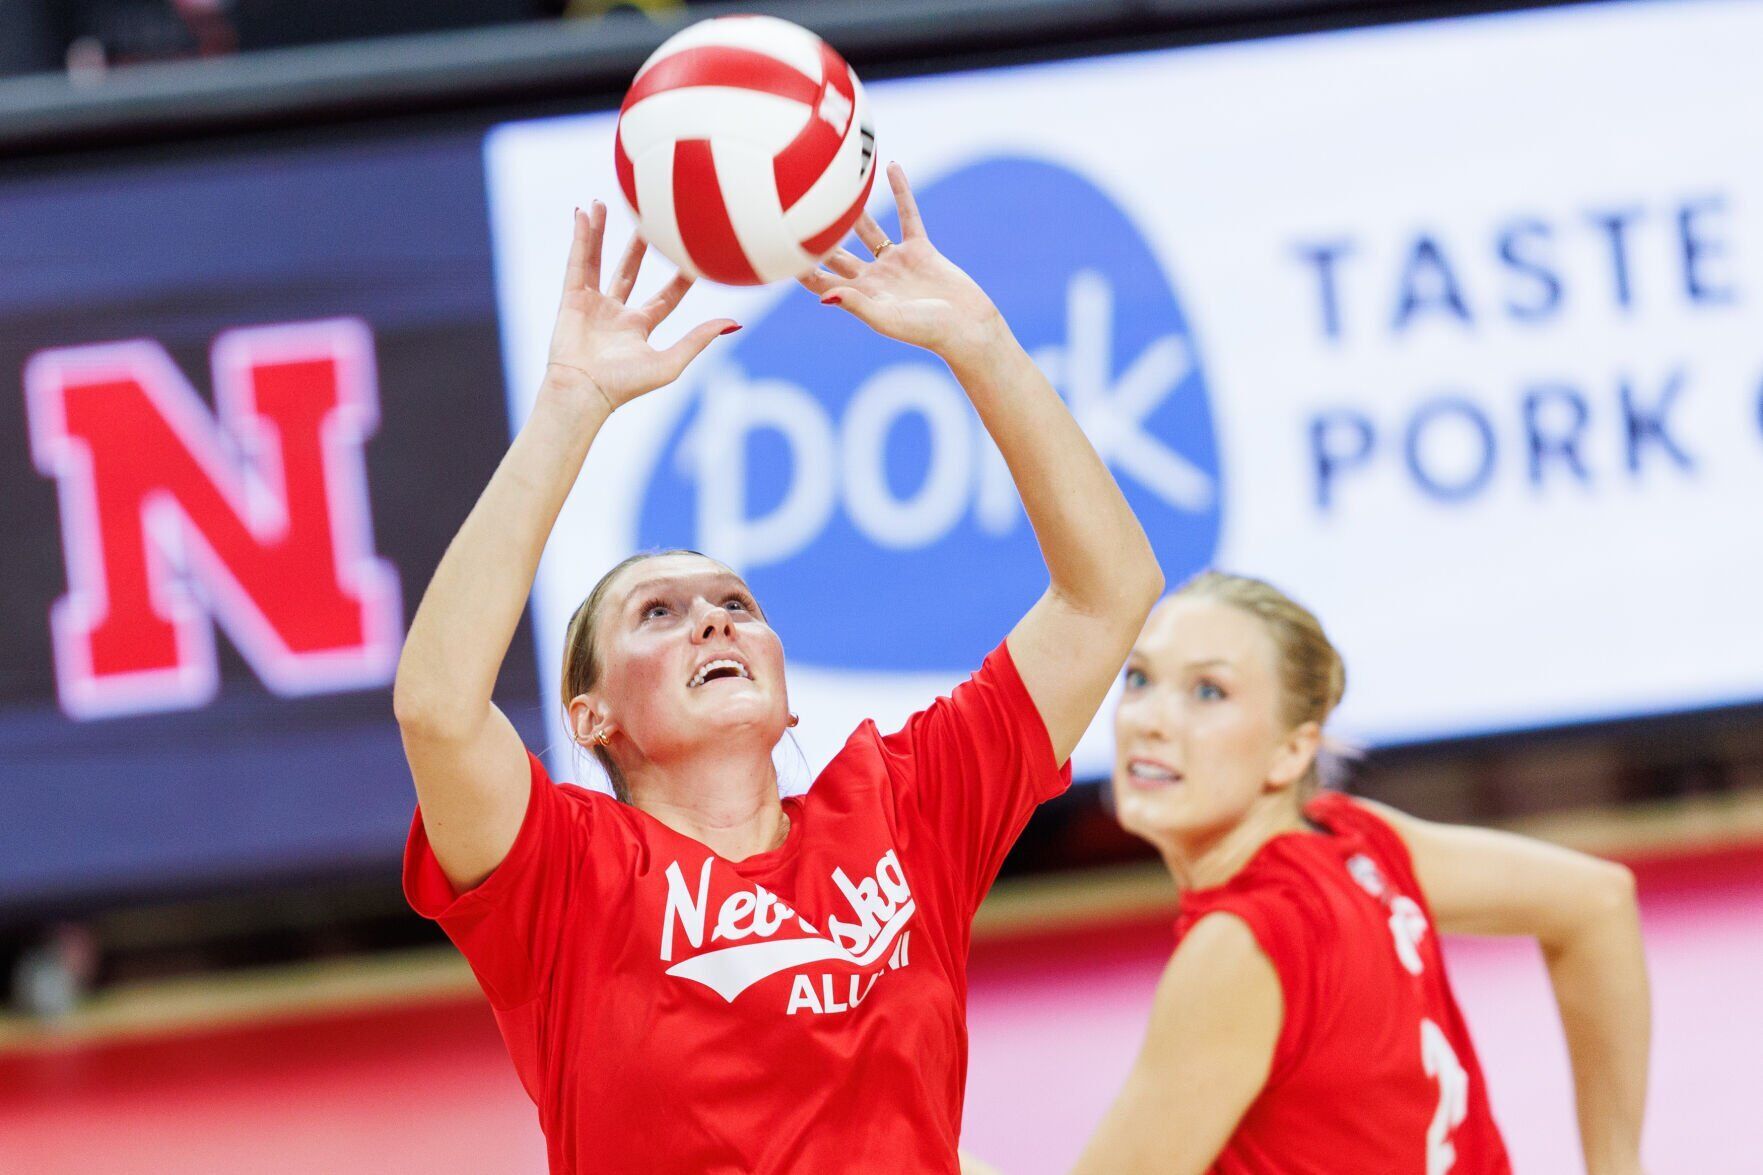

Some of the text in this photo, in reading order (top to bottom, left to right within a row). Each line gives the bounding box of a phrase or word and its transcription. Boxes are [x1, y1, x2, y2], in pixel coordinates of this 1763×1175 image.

[1290, 192, 1737, 340] TASTE
[1309, 362, 1696, 508] PORK
[24, 316, 402, 720] N
[660, 848, 911, 961] Nebska
